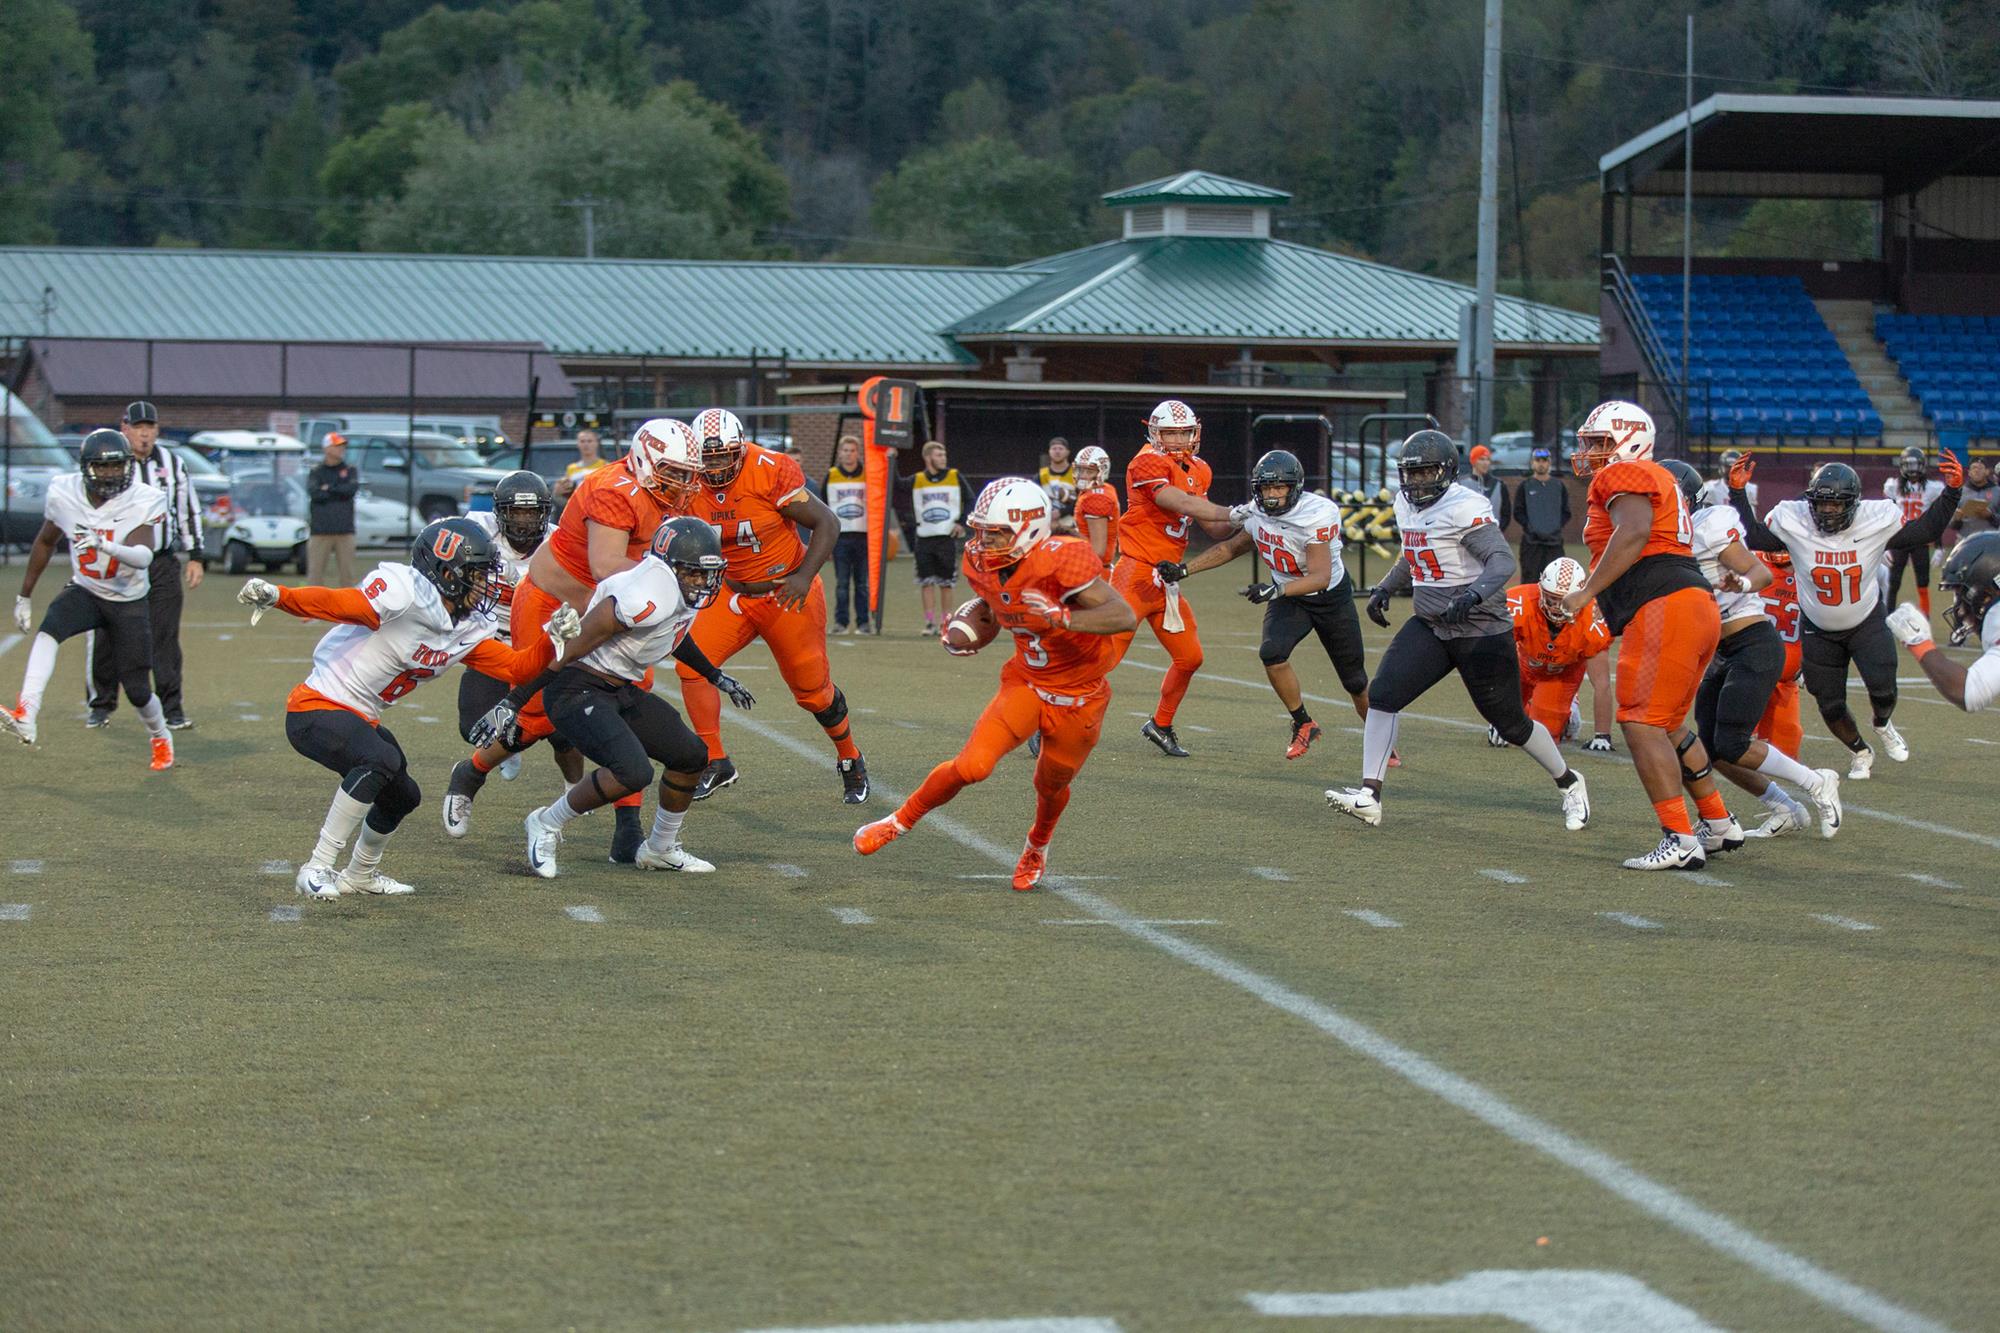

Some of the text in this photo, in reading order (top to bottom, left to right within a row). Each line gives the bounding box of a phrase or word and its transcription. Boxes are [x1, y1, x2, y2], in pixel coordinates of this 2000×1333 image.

[887, 386, 903, 422] 1
[613, 475, 640, 497] 71
[710, 509, 737, 521] UPIKE
[433, 528, 464, 562] U
[654, 525, 678, 556] U
[1256, 538, 1305, 578] 50
[1815, 550, 1858, 566] UNION
[364, 577, 388, 601] 6
[1810, 564, 1863, 607] 91
[632, 600, 657, 624] 1
[1506, 595, 1523, 617] 75
[412, 643, 450, 667] UNIO
[1010, 627, 1049, 668] 3
[378, 667, 435, 703] 6
